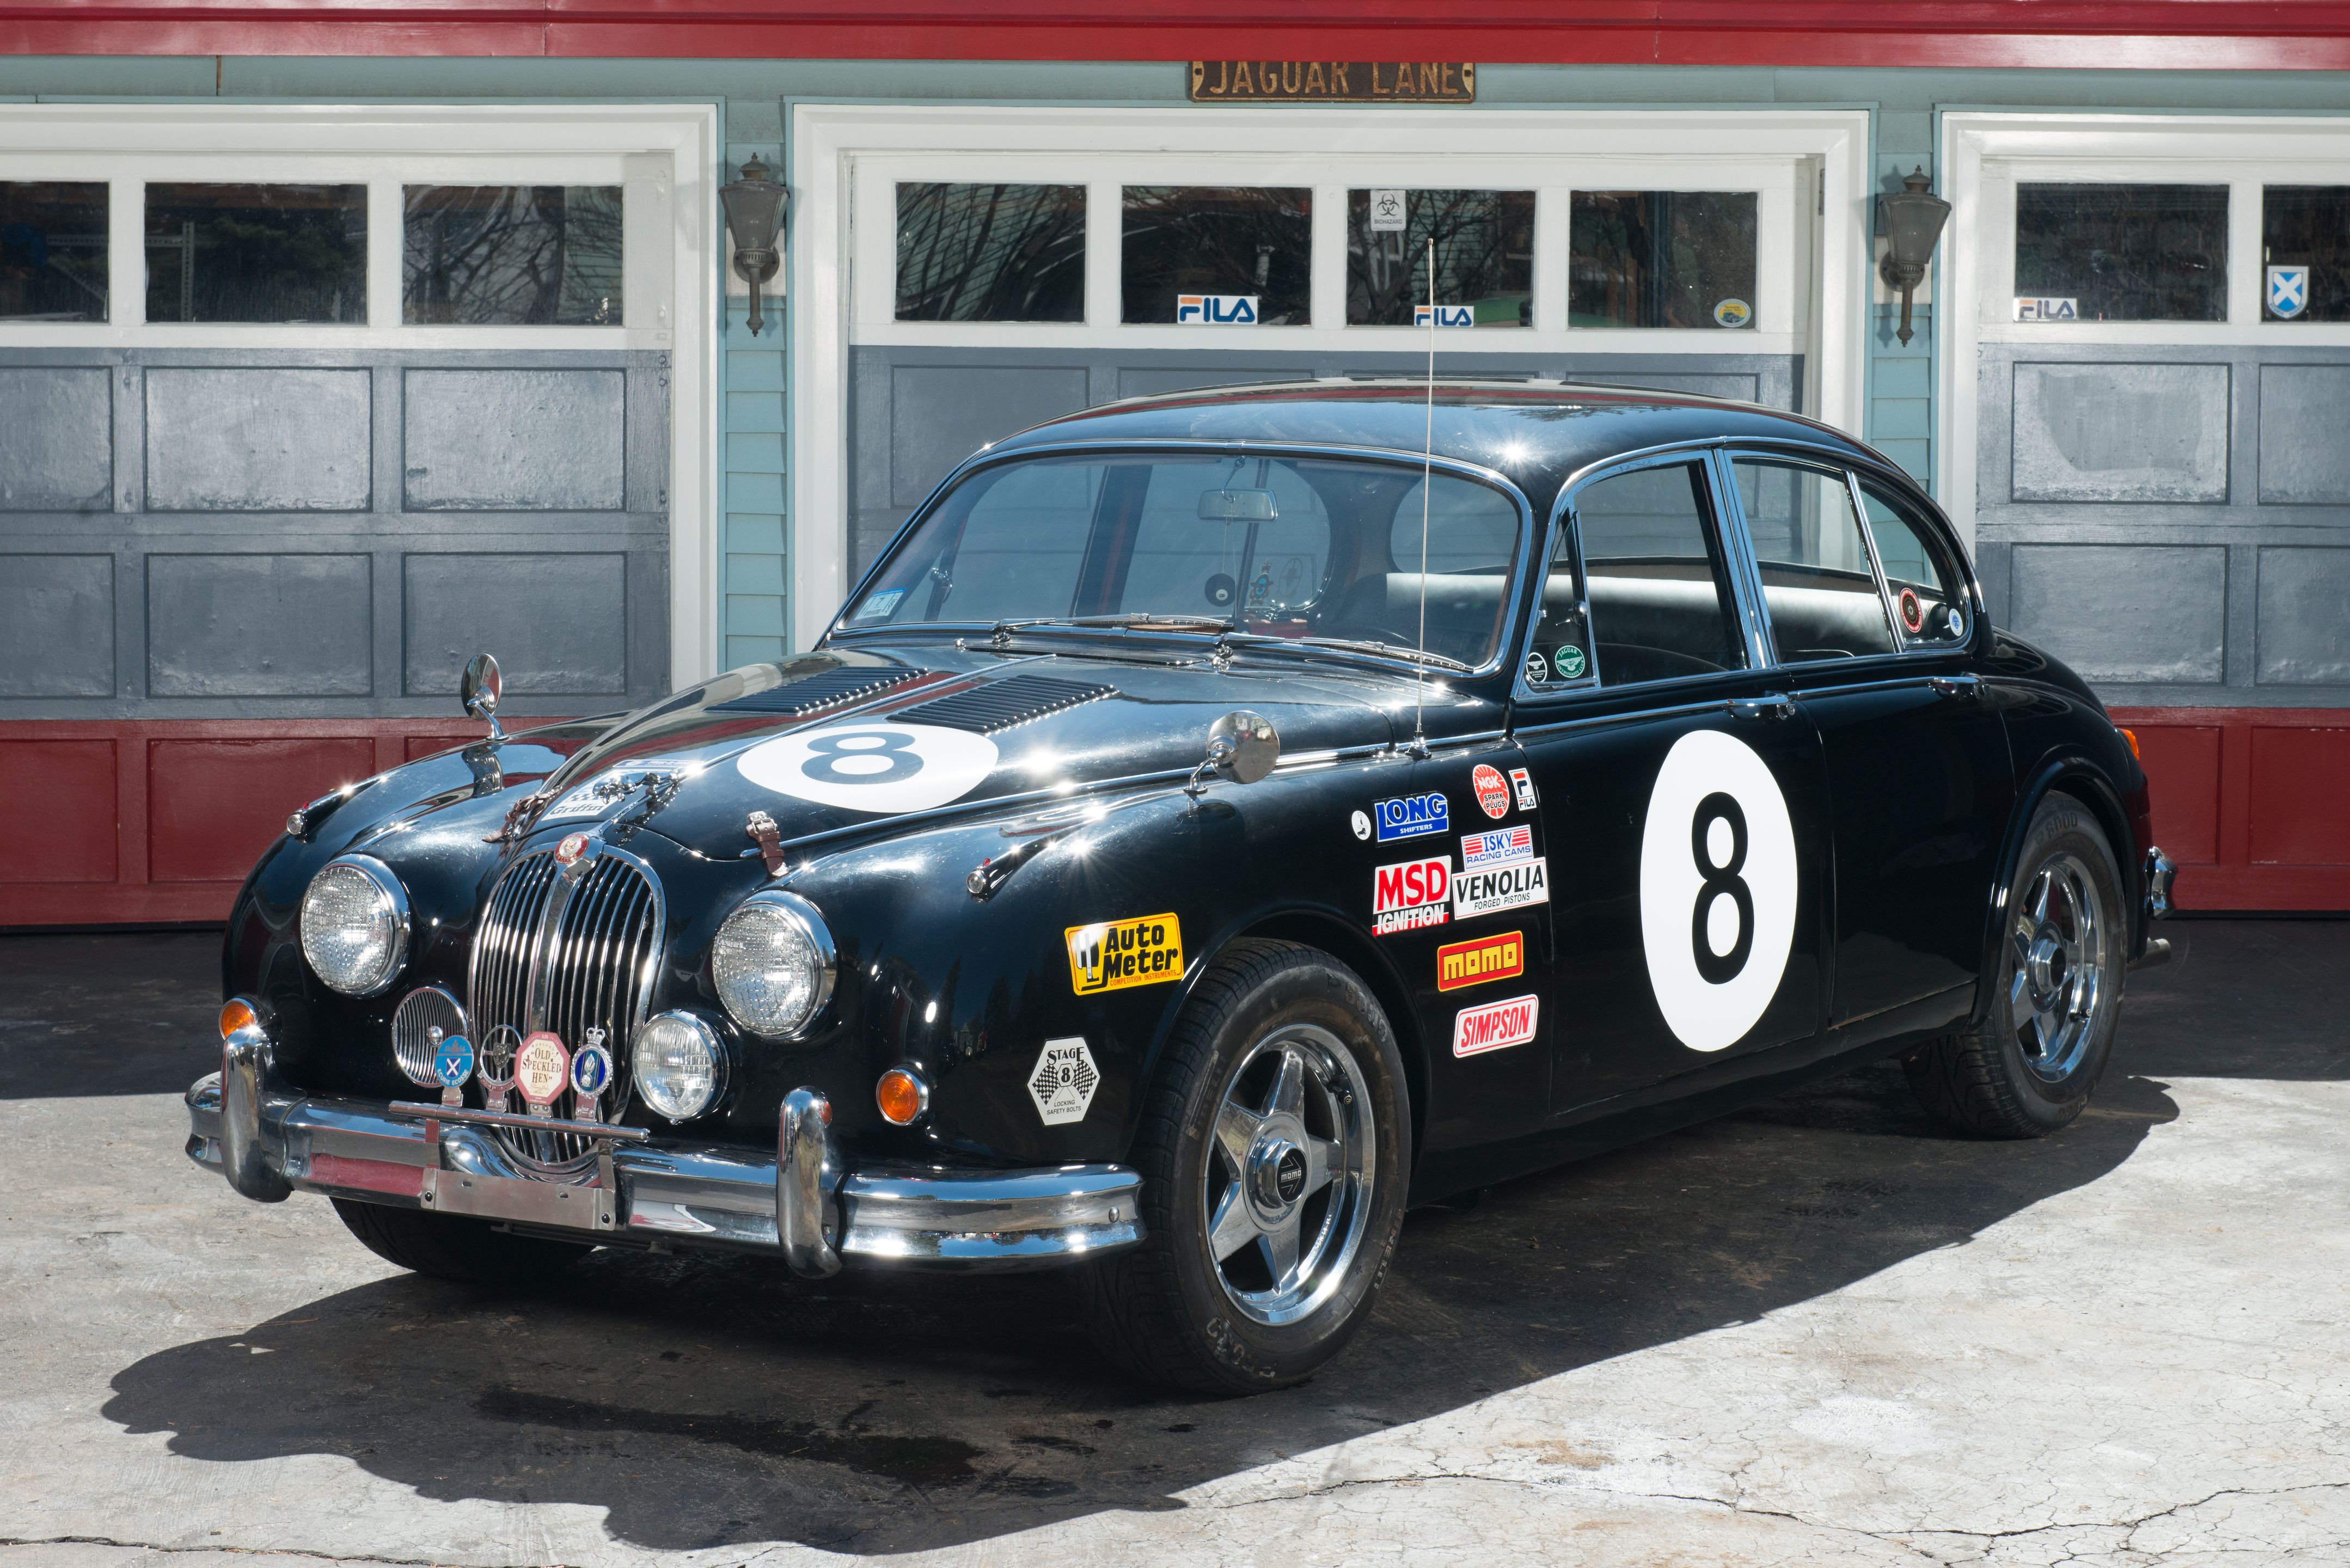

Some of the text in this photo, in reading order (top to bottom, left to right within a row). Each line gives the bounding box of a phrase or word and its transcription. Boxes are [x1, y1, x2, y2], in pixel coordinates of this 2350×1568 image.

[1209, 62, 1459, 94] JAGUAR LANE
[1179, 297, 1256, 323] FILA
[1416, 307, 1472, 326] FILA
[2019, 299, 2075, 319] FILA
[1559, 647, 1577, 658] JAGUAR
[801, 731, 924, 785] 8
[1477, 775, 1501, 790] NGK
[1484, 792, 1503, 801] SPARK
[1486, 800, 1506, 810] PLUGS
[1519, 797, 1535, 808] FILA
[1375, 793, 1448, 842] LONG
[1400, 823, 1433, 834] SHIFTERS
[1483, 832, 1513, 852] ISKY
[1467, 845, 1532, 864] RACING CAMS
[1377, 861, 1447, 911] MSD
[1456, 865, 1545, 904] VENOLIA
[1692, 792, 1754, 985] 8
[1474, 892, 1531, 911] FORGED PISTONS
[1377, 904, 1445, 934] IGNITION
[1104, 923, 1165, 953] Auto
[1102, 948, 1178, 979] Meter
[1110, 969, 1177, 986] COMPETITION INSTRUMENTS
[1461, 1003, 1531, 1049] SIMPSON
[1047, 1046, 1085, 1065] STAGE
[522, 1058, 562, 1073] SPECKLED
[1061, 1067, 1070, 1083] 8
[437, 1068, 469, 1086] ECURIE ECOSSE
[1054, 1099, 1075, 1107] LOCKING
